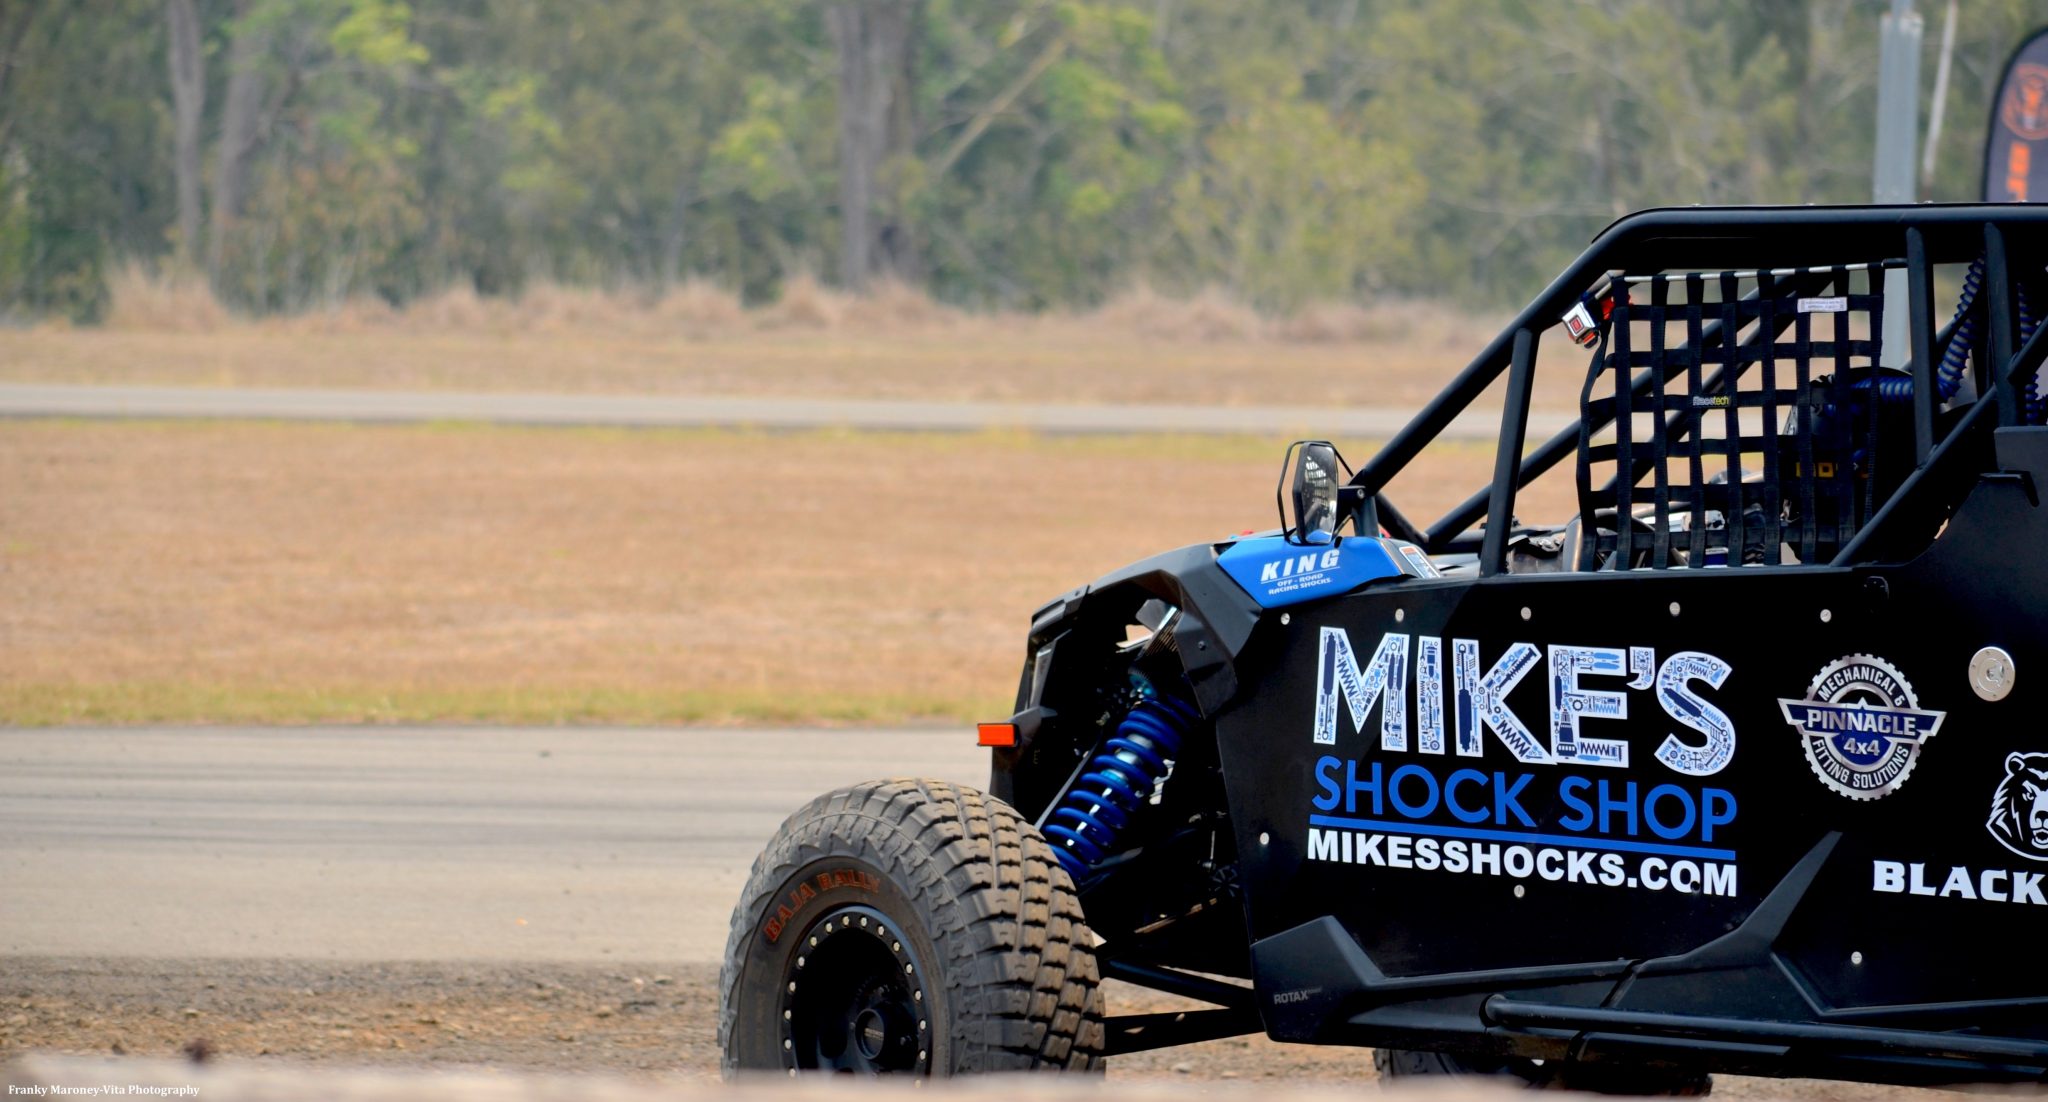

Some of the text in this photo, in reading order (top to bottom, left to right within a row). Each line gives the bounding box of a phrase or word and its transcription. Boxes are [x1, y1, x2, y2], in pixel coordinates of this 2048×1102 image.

[1261, 549, 1340, 582] KING
[1277, 578, 1293, 588] OFF
[1299, 572, 1324, 584] ROAD
[1268, 577, 1332, 595] RACING SHOCKS
[1313, 626, 1737, 777] MIKE'S
[1817, 666, 1898, 702] MECHANICAL
[1806, 708, 1917, 737] PINNACLE
[1812, 738, 1910, 790] FITTING SOLUTIONS
[1843, 737, 1881, 757] 4x4
[1311, 754, 1738, 843] SHOCK SHOP
[1307, 828, 1738, 898] MIKESSHOCKS.COM
[1872, 860, 2048, 905] BLACK
[763, 869, 880, 941] BAJA RALLY
[1273, 990, 1308, 1005] ROTAX
